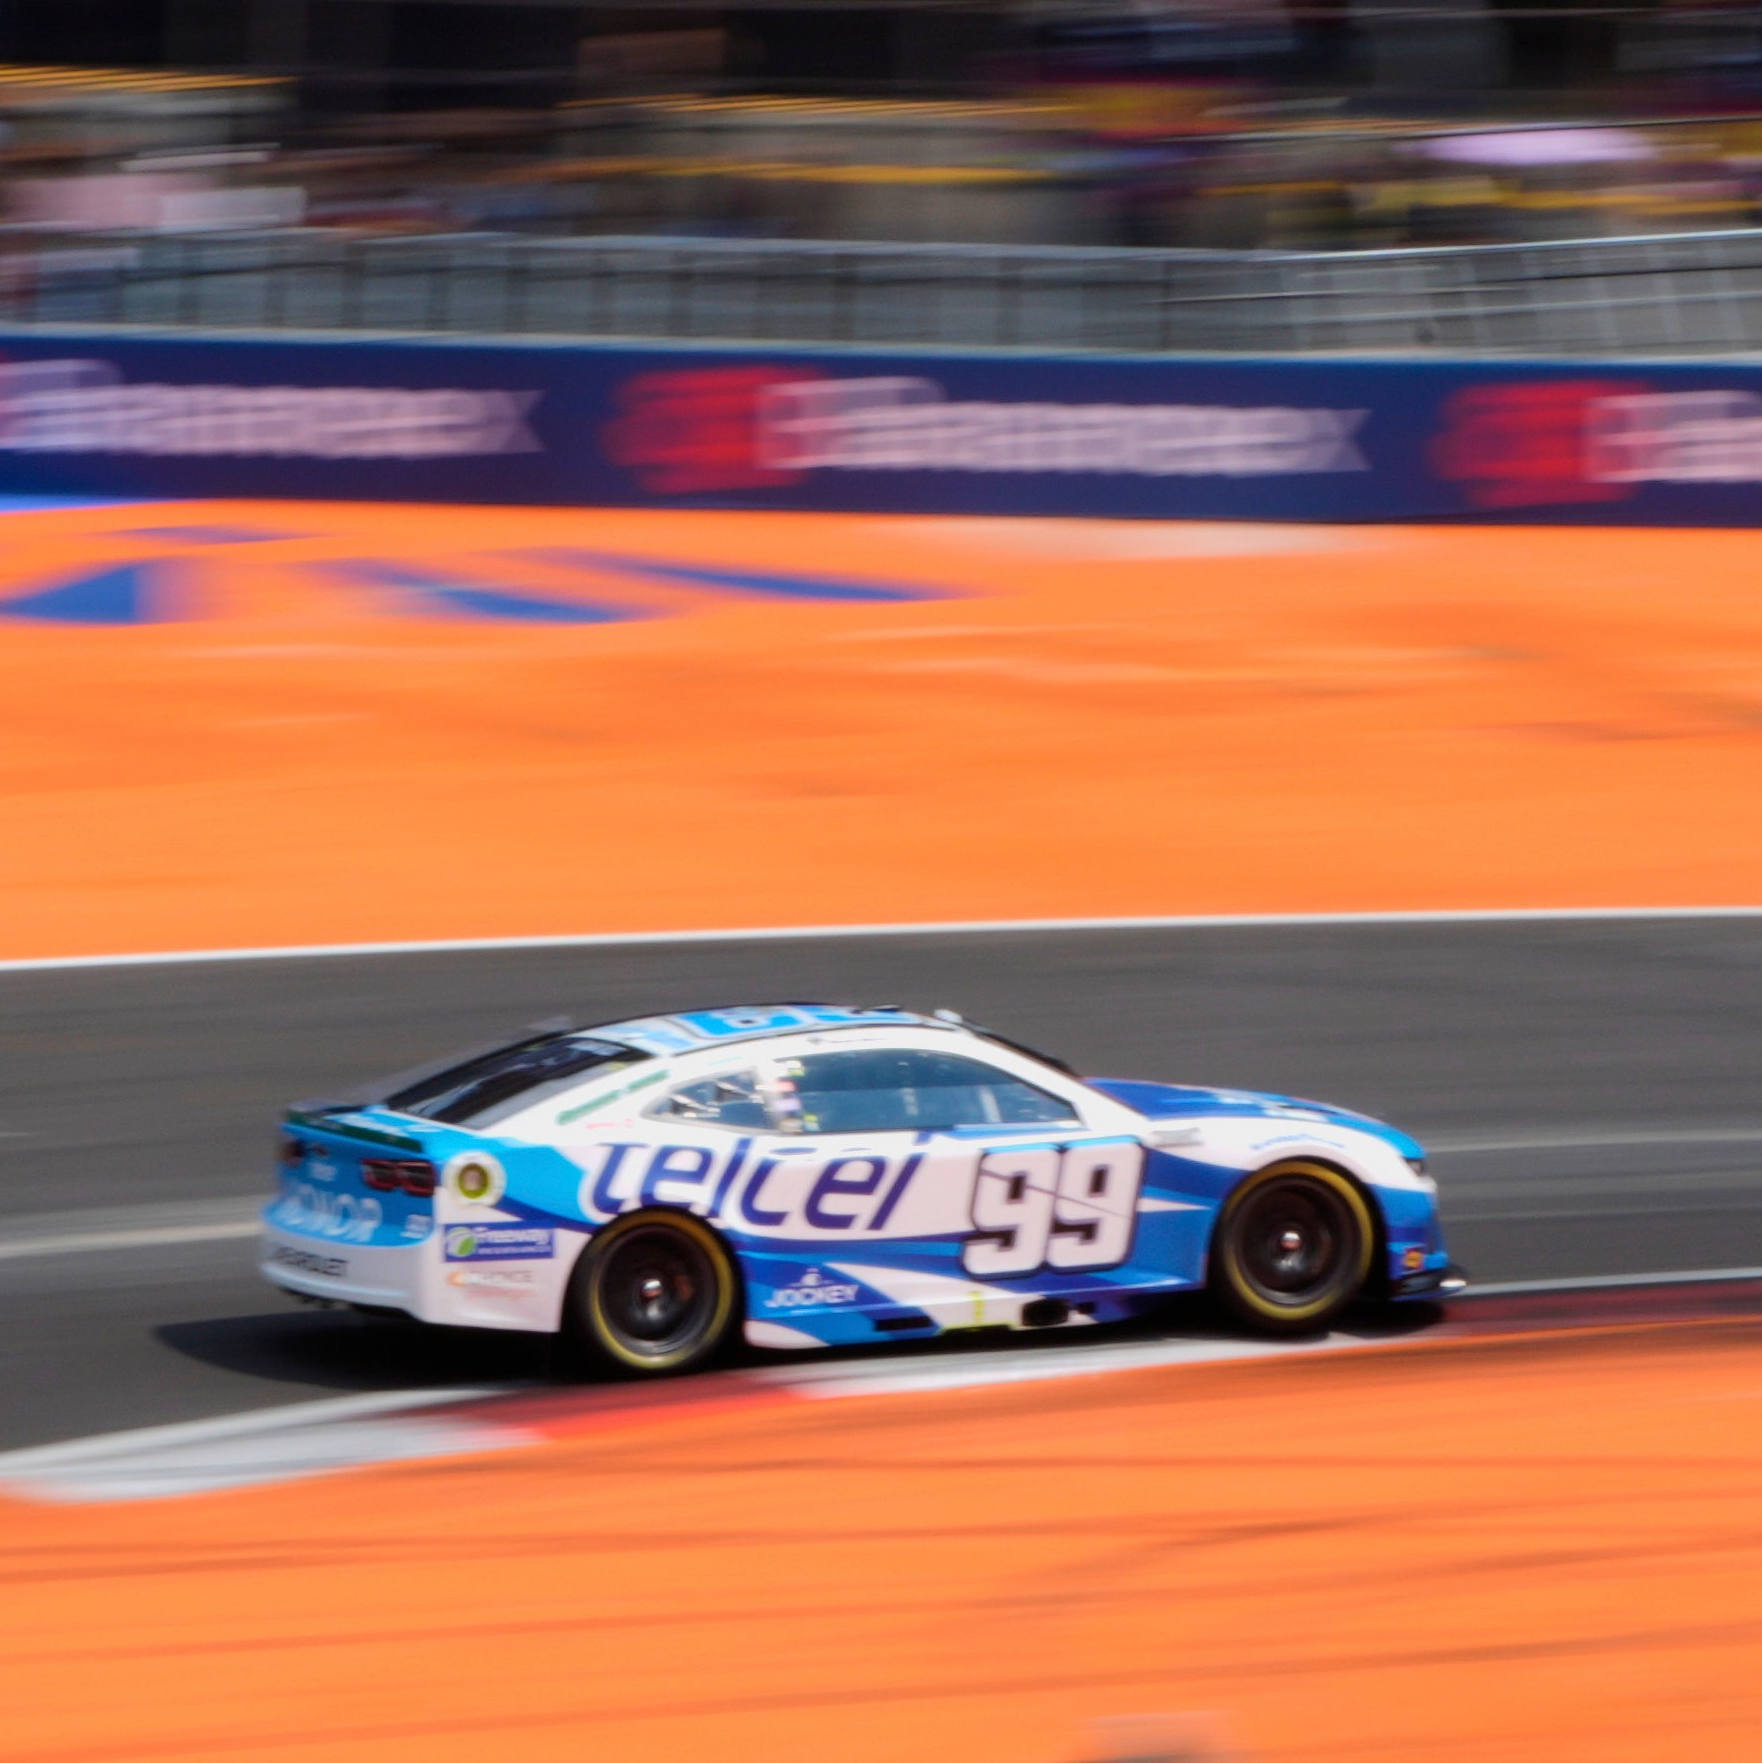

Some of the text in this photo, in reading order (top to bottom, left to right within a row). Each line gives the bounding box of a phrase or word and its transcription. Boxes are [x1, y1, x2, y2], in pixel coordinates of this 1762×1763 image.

[591, 1131, 931, 1230] telcel
[964, 1136, 1145, 1279] 99
[763, 1284, 859, 1308] JOCKEY
